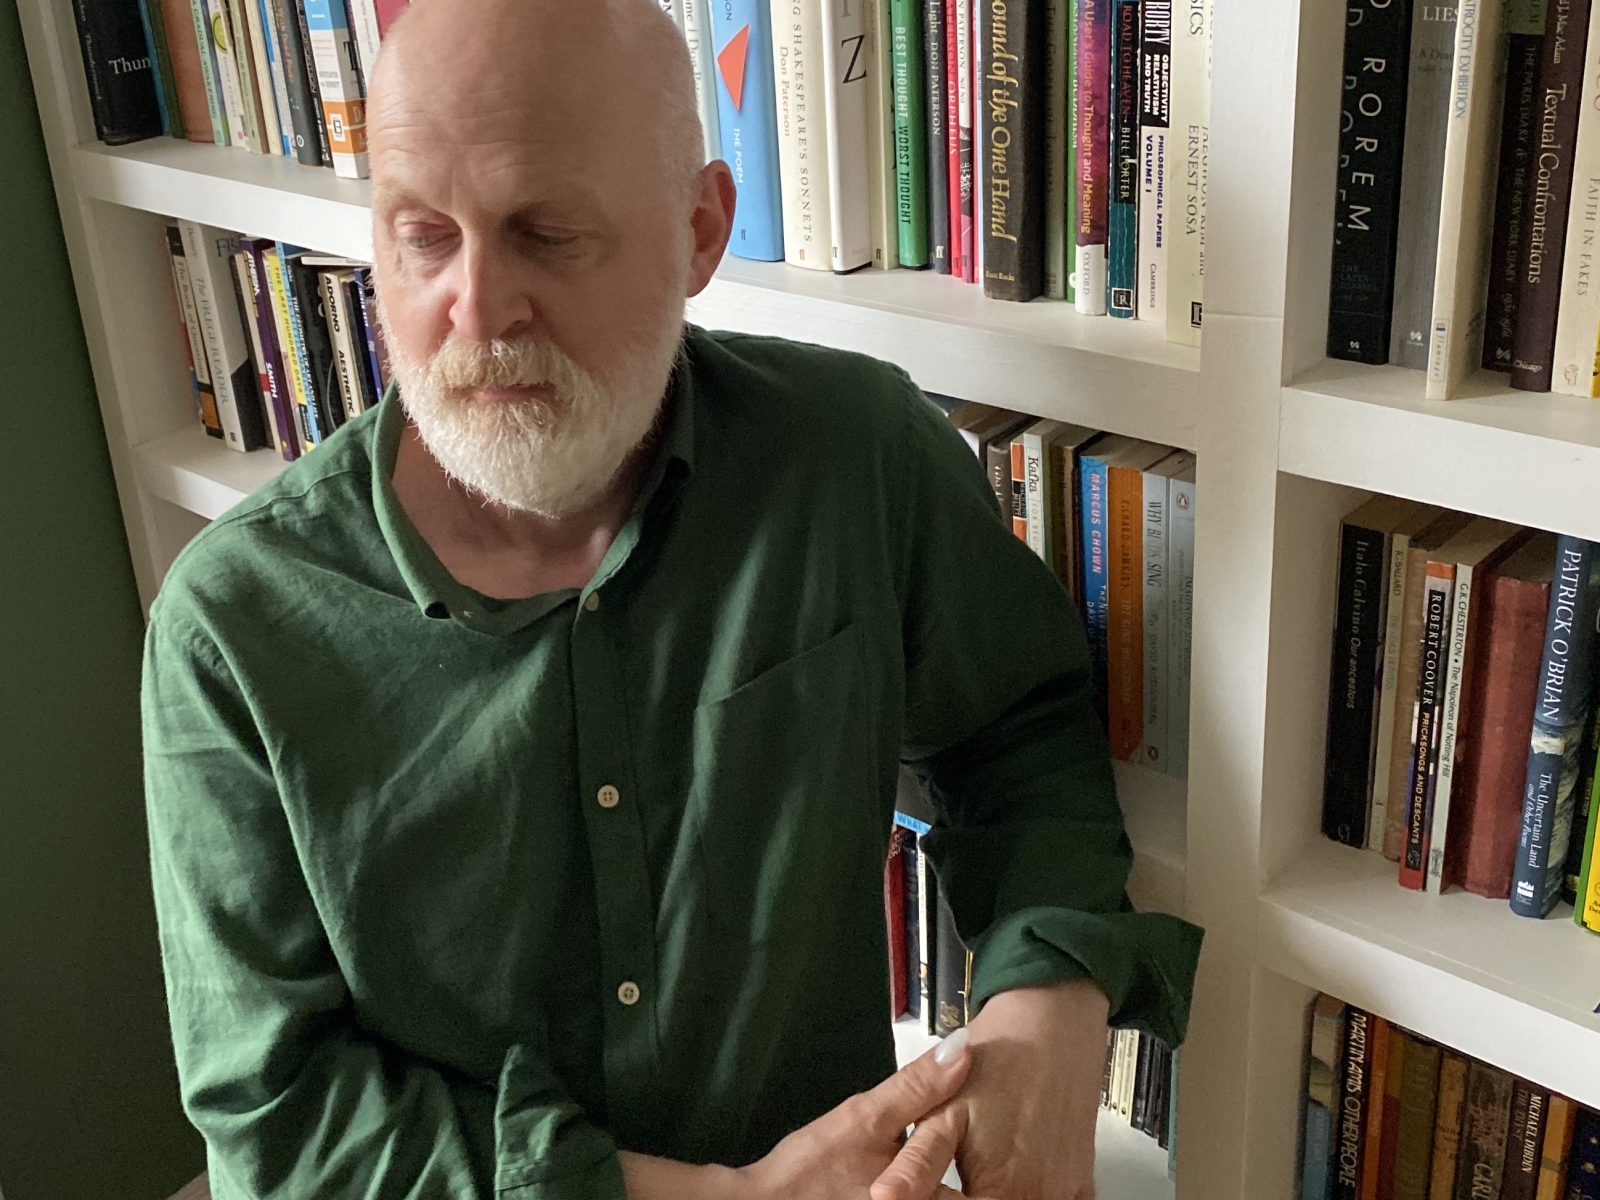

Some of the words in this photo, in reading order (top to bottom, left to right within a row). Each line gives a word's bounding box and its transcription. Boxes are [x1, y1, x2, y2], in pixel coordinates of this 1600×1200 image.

[928, 1, 941, 34] Light
[1084, 11, 1095, 51] User's
[1122, 5, 1133, 42] ROAD
[1145, 1, 1170, 46] RORTY
[780, 46, 788, 76] Don
[841, 34, 867, 84] Z
[895, 27, 905, 56] BEST
[930, 42, 938, 70] DON
[1122, 47, 1132, 64] TO
[986, 62, 1018, 88] of
[1084, 52, 1095, 88] Guide
[1144, 53, 1152, 77] AND
[1152, 54, 1160, 116] RELATIVISM
[1455, 55, 1471, 119] EXHIBITION
[782, 81, 790, 137] Paterson
[793, 24, 808, 160] SHAKESPEARE'S
[931, 75, 940, 135] PATERSON
[989, 89, 1018, 122] the
[1084, 91, 1093, 103] to
[1121, 65, 1131, 115] HEAVEN
[1160, 54, 1169, 123] OBJECTIVITY
[733, 127, 741, 149] THE
[949, 82, 957, 155] ORPHEUS
[1082, 105, 1093, 157] Thought
[1540, 83, 1567, 150] Textual
[897, 126, 909, 168] WORST
[991, 126, 1011, 174] One
[1121, 127, 1130, 155] BILL
[1145, 134, 1153, 185] VOLUME
[1187, 124, 1200, 191] ERNEST
[1347, 56, 1386, 231] ROREM
[736, 151, 744, 184] POEM
[1083, 159, 1092, 182] and
[1120, 156, 1130, 199] PORTER
[1156, 135, 1164, 210] PHILOSOPHICAL
[800, 167, 812, 242] SONNETS
[899, 172, 911, 225] THOUGHT
[991, 176, 1018, 244] Hand
[1081, 184, 1093, 234] Meaning
[1186, 195, 1198, 236] SOSA
[1528, 152, 1561, 284] Confrontations
[1584, 178, 1600, 222] FAITH
[1155, 213, 1163, 249] PAPERS
[1583, 229, 1595, 246] IN
[1083, 252, 1091, 296] OXFORD
[1577, 253, 1592, 297] FAKES
[275, 267, 283, 284] THE
[279, 288, 289, 314] LAST
[284, 318, 298, 366] HUNDRED
[325, 275, 341, 333] ADORNO
[338, 350, 355, 414] AESTHETIC
[265, 362, 279, 399] SMITH
[1028, 456, 1040, 494] Kafka
[1090, 473, 1101, 525] MARCUS
[1147, 501, 1162, 526] WHY
[1091, 530, 1102, 574] CHOWN
[1355, 540, 1369, 576] Italo
[1147, 561, 1162, 588] SING
[1553, 549, 1583, 636] PATRICK
[1350, 579, 1368, 634] Calvino
[1428, 593, 1442, 648] ROBERT
[1350, 637, 1362, 660] Our
[1454, 601, 1467, 658] CHESTERTON
[1346, 661, 1361, 709] ancestors
[1423, 650, 1437, 705] COOVER
[1451, 665, 1461, 681] The
[1543, 639, 1569, 721] O'BRIAN
[1446, 683, 1459, 722] Napoleon
[1416, 711, 1430, 772] PRICKSONGS
[1442, 731, 1454, 763] Notting
[1414, 774, 1424, 795] AND
[1442, 763, 1451, 778] Hill
[1538, 773, 1552, 793] The
[1411, 795, 1423, 844] DESCANTS
[1524, 799, 1535, 826] Other
[1531, 793, 1549, 843] Uncertain
[1528, 844, 1543, 869] Land
[1349, 1012, 1367, 1062] MARTIN
[1347, 1062, 1364, 1097] AMIS
[1342, 1097, 1362, 1140] OTHER
[1526, 1092, 1542, 1138] MICHAEL
[1338, 1139, 1358, 1188] PEOPLE
[1521, 1138, 1536, 1175] DIBDIN
